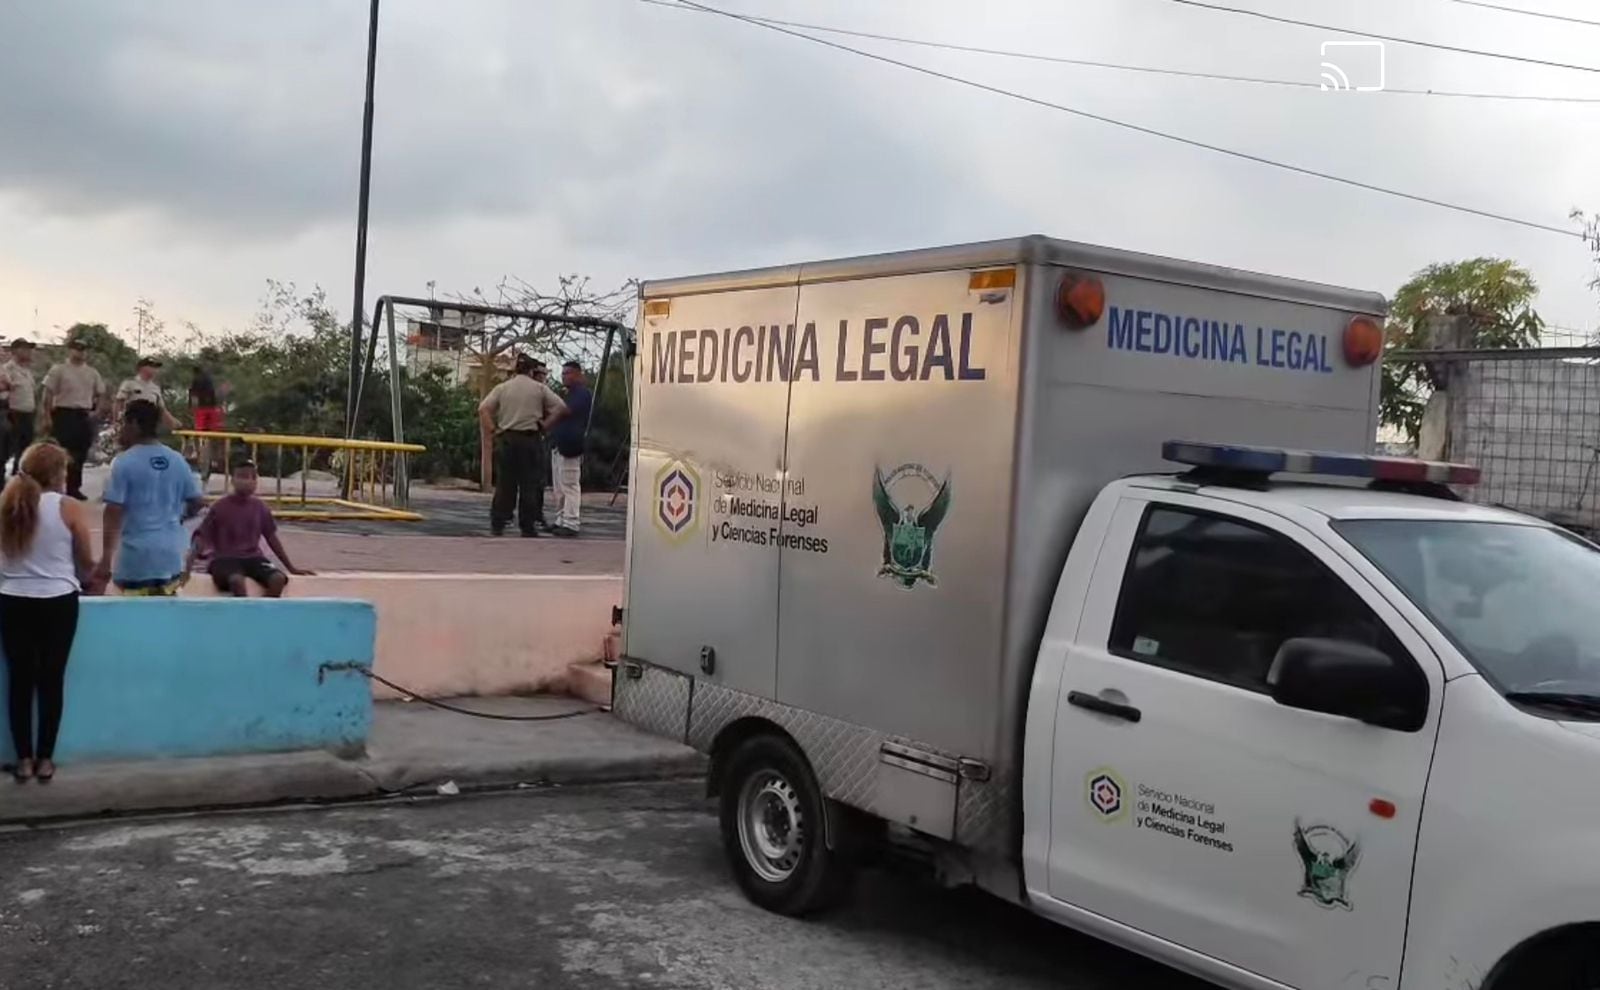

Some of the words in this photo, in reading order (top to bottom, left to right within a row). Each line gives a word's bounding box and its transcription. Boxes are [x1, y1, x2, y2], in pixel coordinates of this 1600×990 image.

[650, 321, 820, 384] MEDICINA
[835, 312, 986, 382] LEGAL
[1108, 307, 1247, 363] MEDICINA
[1256, 327, 1333, 373] LEGAL
[756, 474, 804, 495] Nacinal
[713, 497, 727, 514] de
[730, 497, 779, 521] Medicina
[782, 505, 818, 528] Legal
[712, 524, 719, 540] y
[721, 521, 767, 545] Ciencias
[769, 529, 829, 554] Forenses
[1138, 784, 1173, 803] Servicio
[1174, 794, 1215, 814] Nacional
[1136, 816, 1144, 829] y
[1145, 815, 1186, 839] Ciencias
[1187, 828, 1234, 853] Forenses
[1137, 799, 1150, 813] de
[1151, 802, 1195, 826] Medicina
[1197, 814, 1226, 835] Legal
